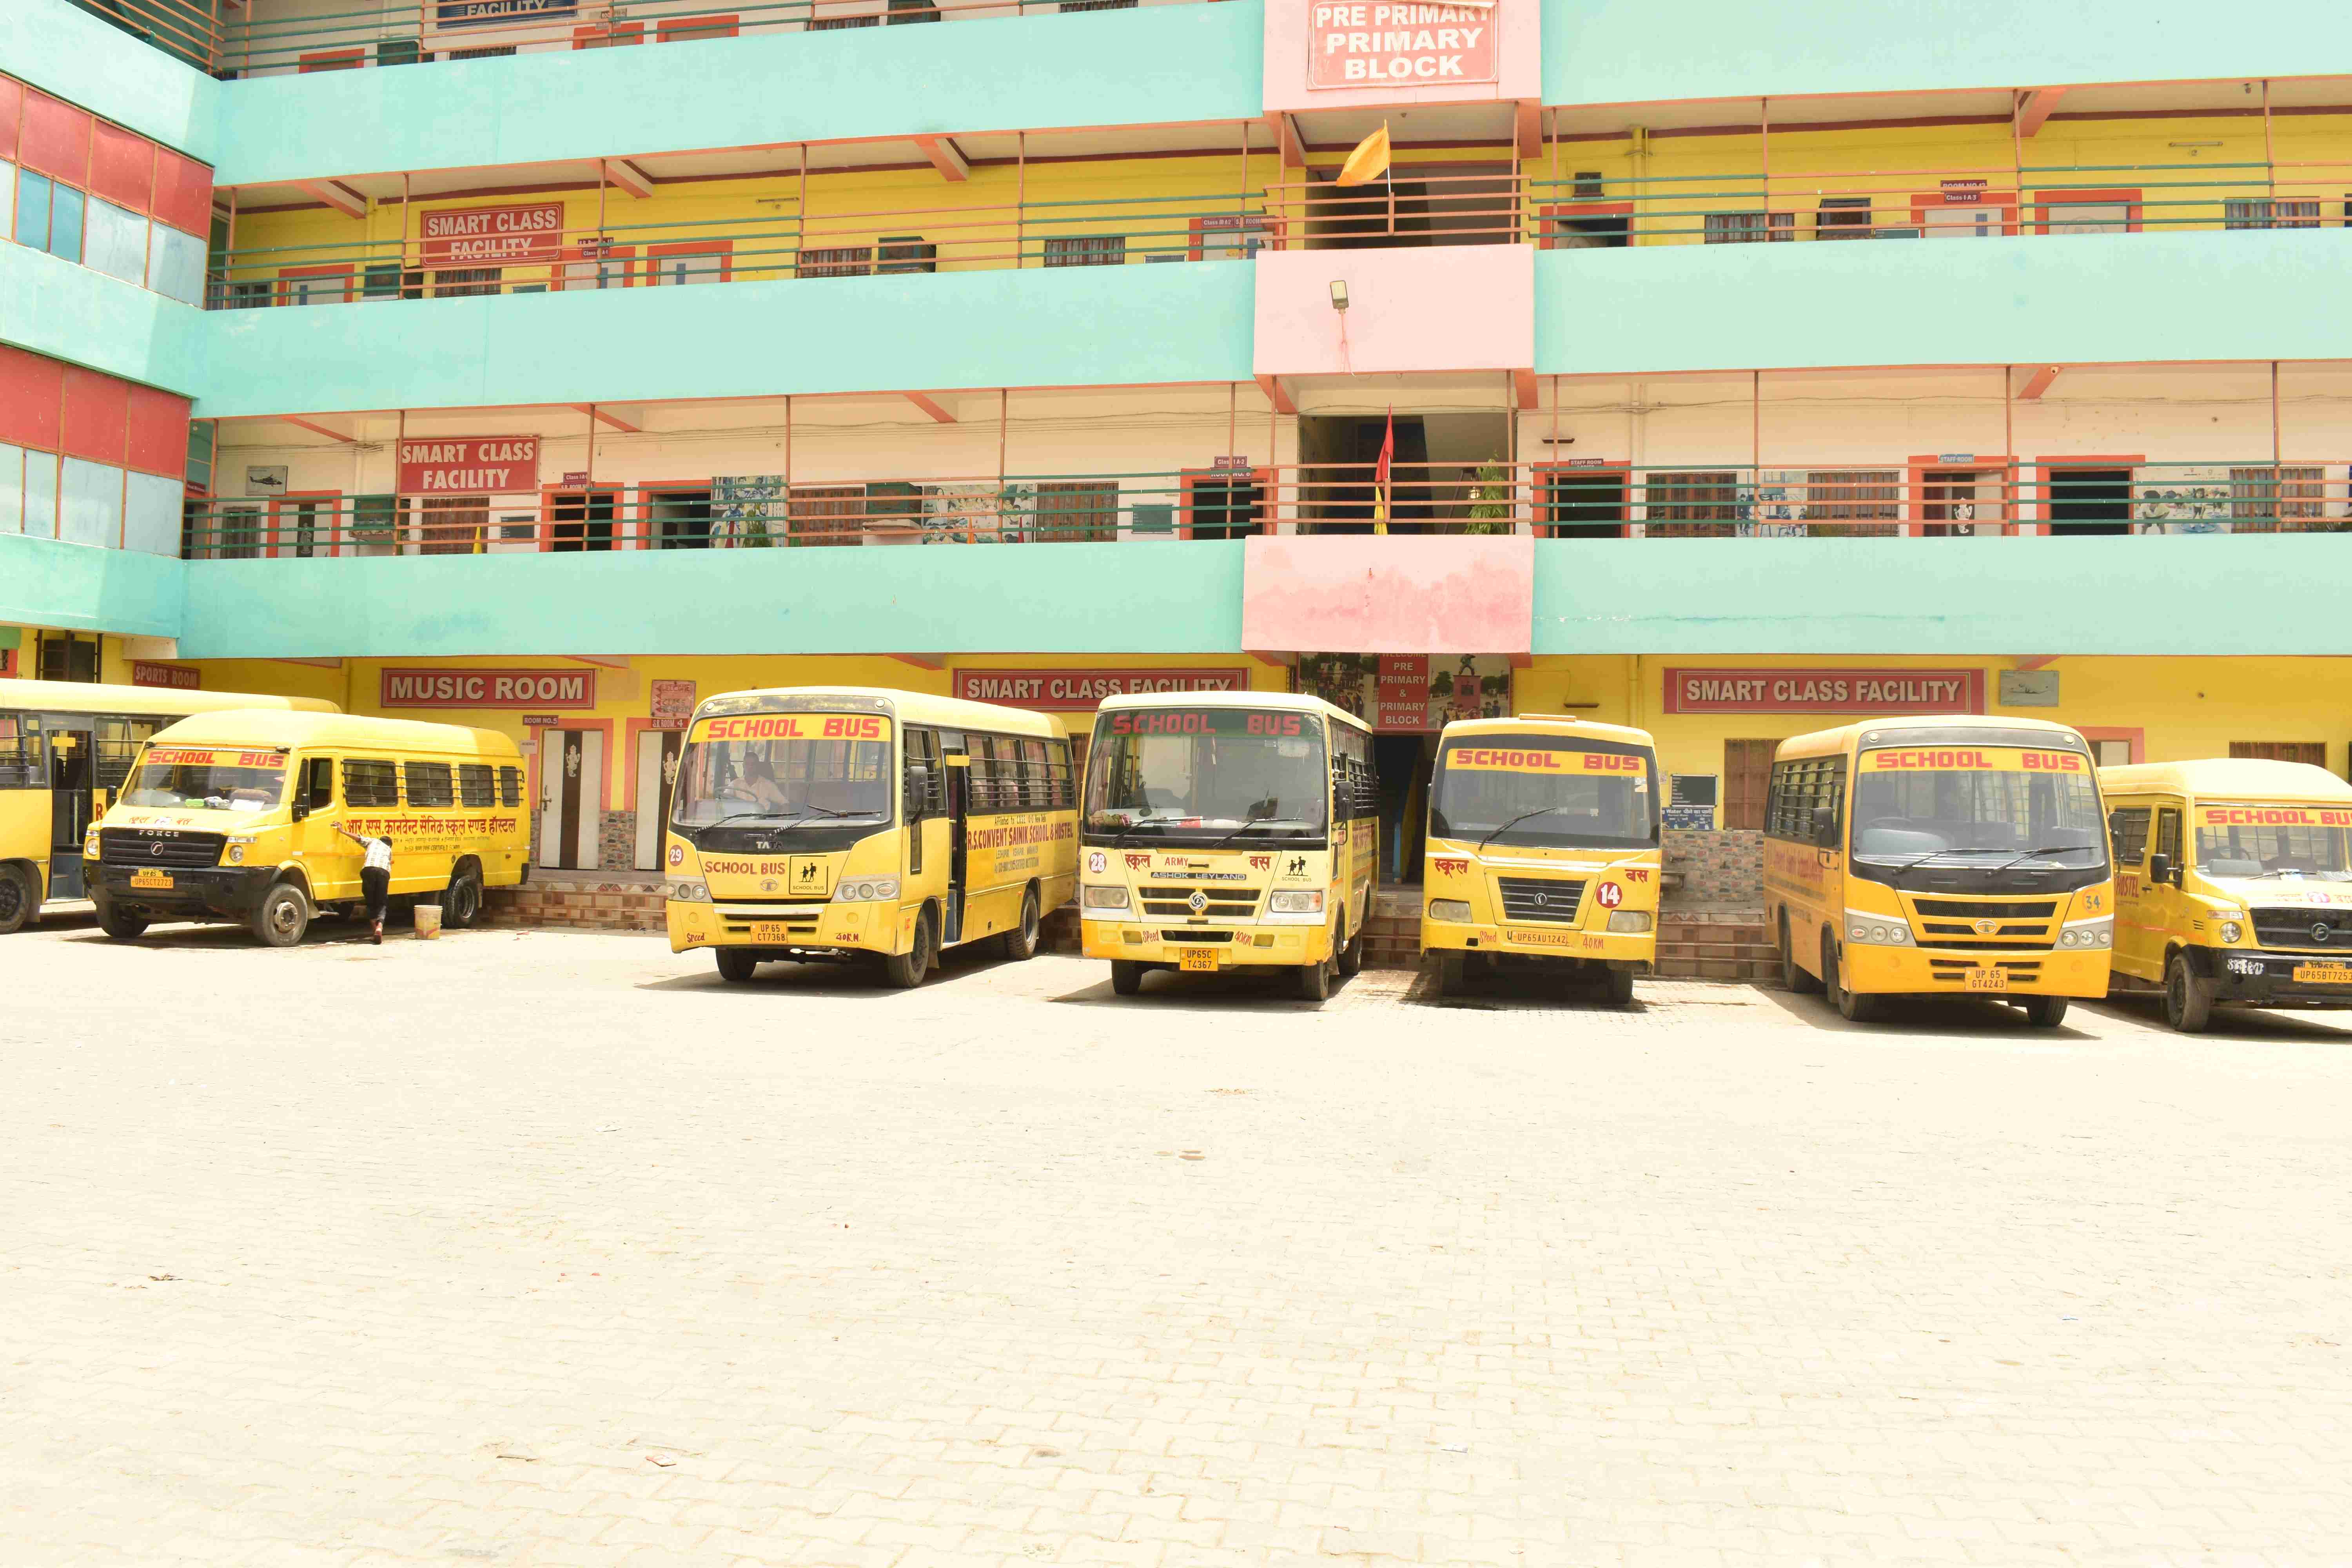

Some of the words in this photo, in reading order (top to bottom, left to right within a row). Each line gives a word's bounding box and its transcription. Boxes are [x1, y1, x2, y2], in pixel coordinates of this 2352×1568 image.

[467, 0, 546, 16] FACILITY
[1317, 6, 1366, 27] PRE
[1375, 5, 1490, 25] PRIMARY
[1327, 27, 1483, 54] PRIMARY
[1345, 55, 1463, 79] BLOCK
[428, 214, 491, 236] SMART
[497, 210, 556, 231] CLASS
[451, 238, 533, 260] FACILITY
[402, 445, 467, 463] SMART
[479, 443, 534, 461] CLASS
[423, 469, 510, 489] FACILITY
[1394, 662, 1413, 671] PRE
[136, 666, 167, 683] SPORTS
[172, 670, 196, 687] ROOM
[1381, 676, 1426, 684] PRIMARY
[390, 677, 485, 700] MUSIC
[495, 677, 584, 700] ROOM
[967, 679, 1043, 699] SMART
[1050, 679, 1122, 699] CLASS
[1129, 679, 1232, 693] FACILITY
[1399, 689, 1406, 697] &
[1687, 680, 1766, 701] SMART
[1773, 681, 1849, 702] CLASS
[1856, 681, 1960, 702] FACILITY
[1380, 702, 1425, 711] PRIMARY
[708, 719, 804, 738] SCHOOL
[823, 718, 880, 738] BUS
[1113, 714, 1216, 735] SCHOOL
[1247, 715, 1301, 736] BUS
[1386, 716, 1419, 724] BLOCK
[147, 751, 215, 764] SCHOOL
[238, 753, 284, 767] BUS
[1456, 750, 1560, 768] SCHOOL
[1584, 754, 1640, 771] BUS
[1876, 752, 1993, 768] SCHOOL
[2022, 753, 2080, 771] BUS
[2206, 810, 2315, 824] SCHOOL
[2320, 811, 2352, 825] BU
[445, 819, 465, 836] स्कूल
[1009, 826, 1029, 845] SAINIK
[1029, 824, 1049, 843] SCHOOL
[1054, 822, 1073, 840] HOSTEL
[670, 849, 682, 862] 29
[1091, 854, 1105, 871] 28
[1125, 854, 1151, 872] स्कूल
[1249, 856, 1271, 872] बस
[1165, 857, 1188, 867] ARMY
[705, 861, 757, 875] SCHOOL
[761, 862, 785, 875] BUS
[1434, 858, 1469, 878] स्कूल
[1625, 869, 1649, 884] बस
[135, 878, 172, 886] UP65CT2723
[1601, 884, 1619, 905] 14
[2085, 896, 2100, 909] 34
[758, 933, 784, 941] CT7368
[1518, 934, 1566, 944] UP65AU1242
[1187, 950, 1211, 958] UP65C
[1188, 960, 1212, 969] T4367
[1976, 970, 1985, 978] UP
[1990, 970, 2000, 978] 65
[2300, 971, 2352, 980] UP65BT7253
[1972, 980, 2004, 988] GT4243
